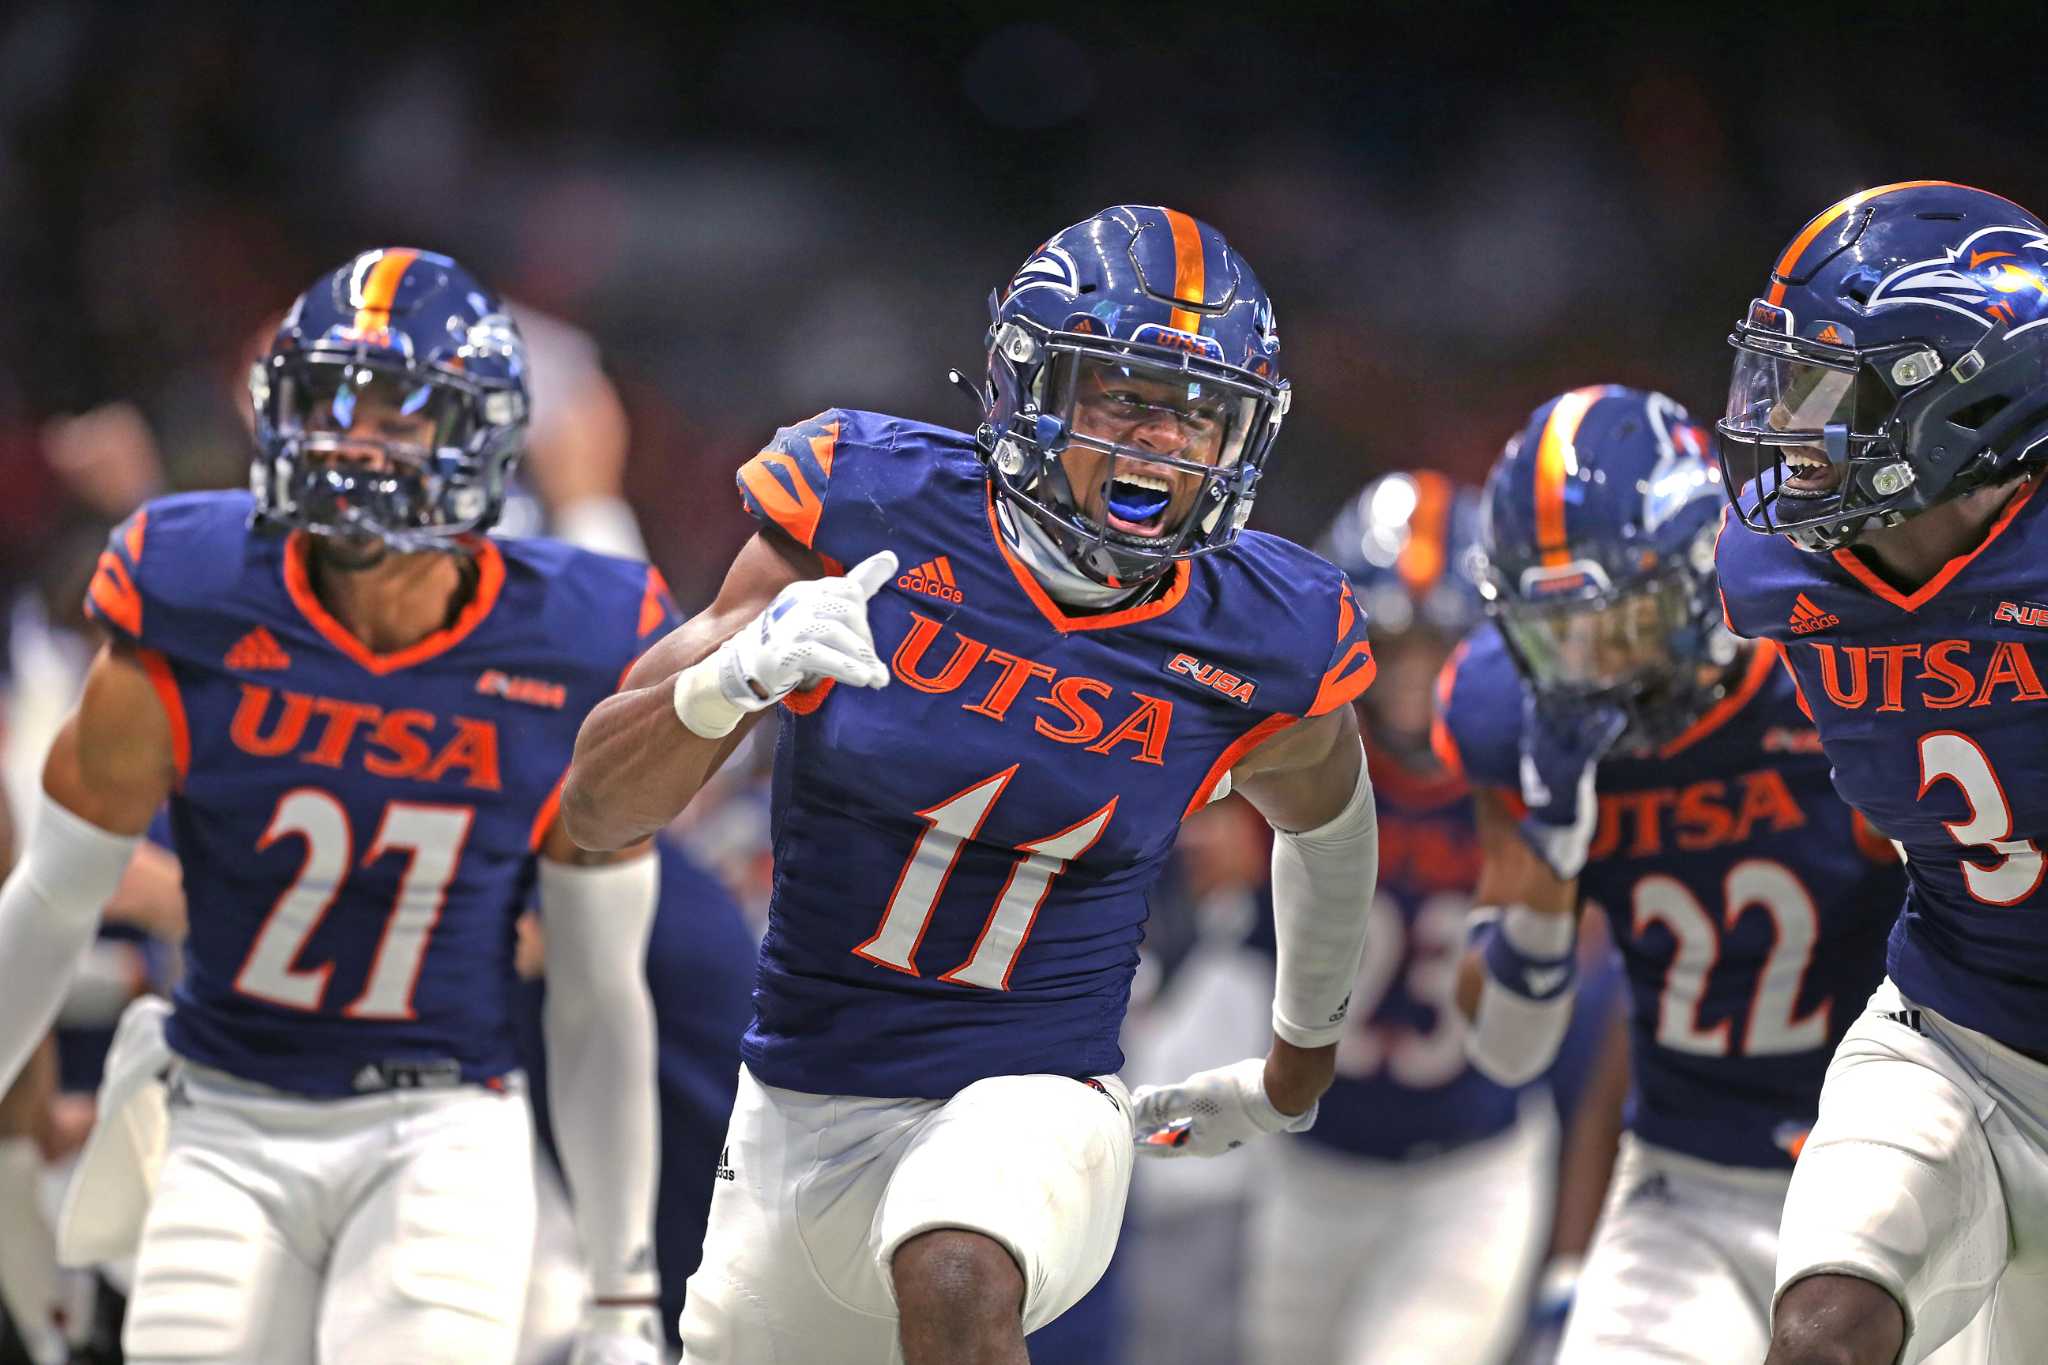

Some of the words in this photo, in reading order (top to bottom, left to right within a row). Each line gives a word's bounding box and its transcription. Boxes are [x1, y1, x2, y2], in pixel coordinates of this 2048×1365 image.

[897, 575, 963, 604] adidas
[1791, 614, 1840, 634] adidas
[229, 682, 503, 791] UTSA
[892, 611, 1174, 766] UTSA
[1809, 639, 2048, 712] UTSA
[852, 763, 1119, 992] 11
[1916, 730, 2048, 906] 3
[232, 785, 477, 1020] 27
[1630, 857, 1834, 1058] 22
